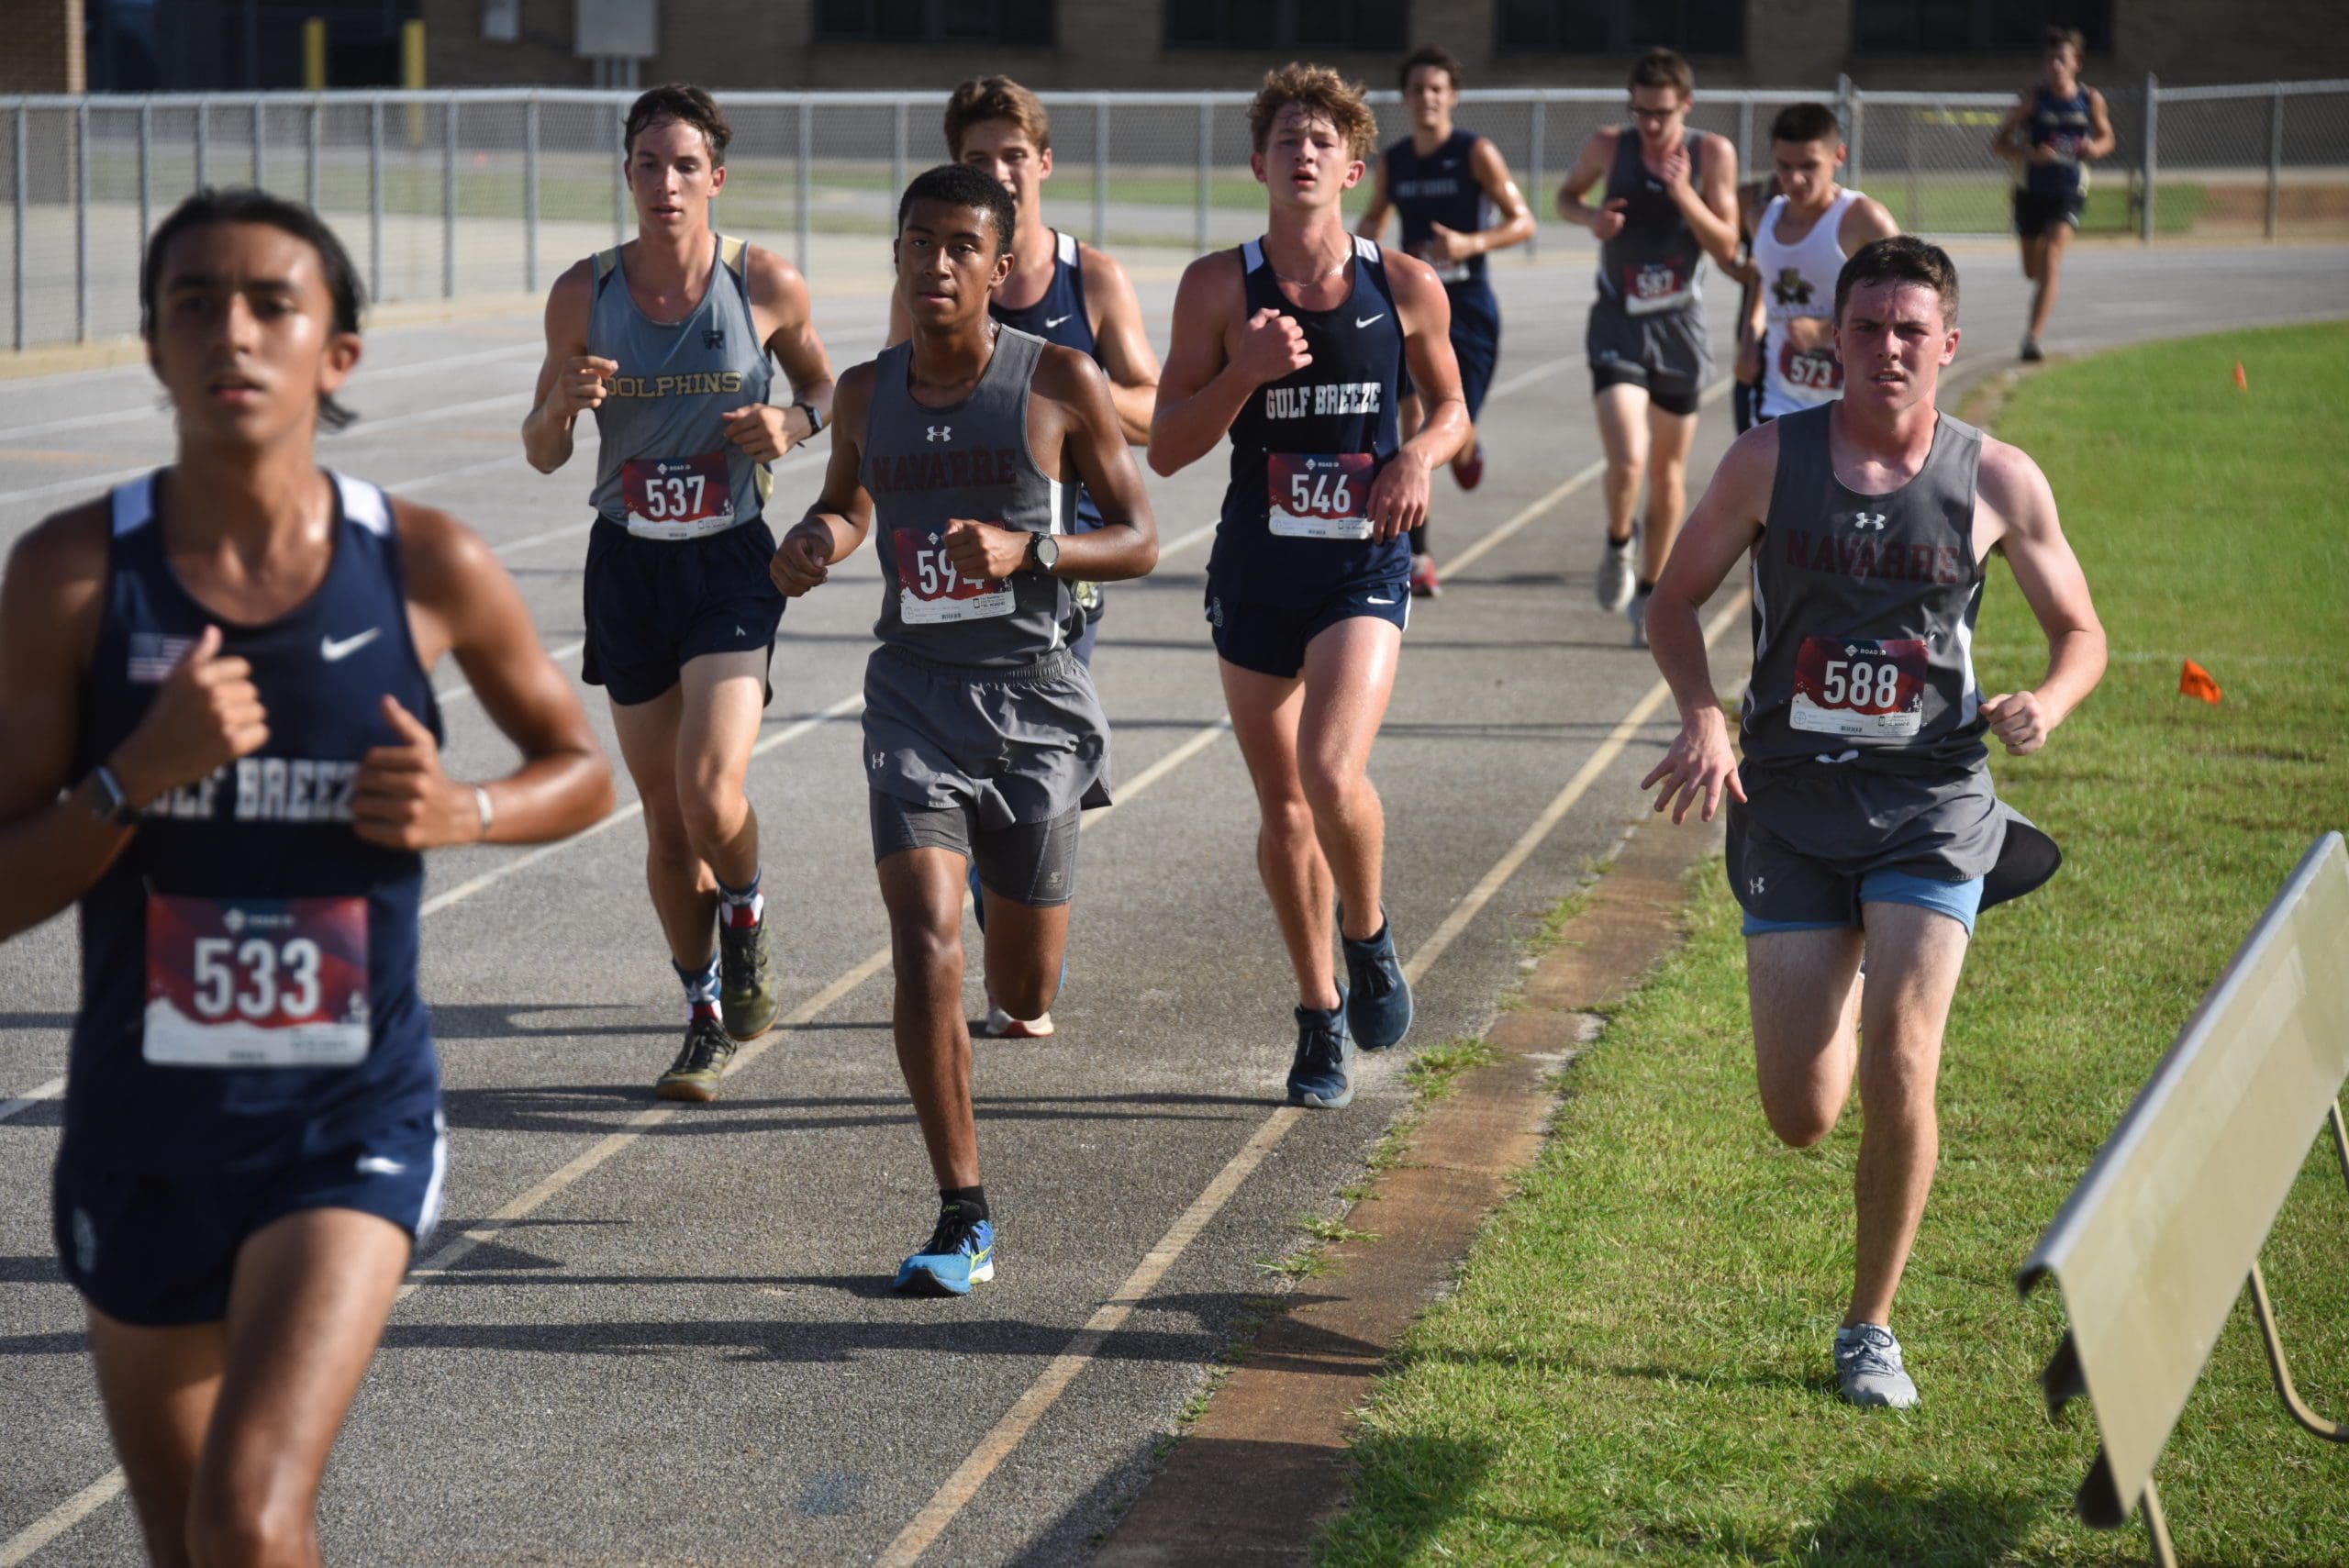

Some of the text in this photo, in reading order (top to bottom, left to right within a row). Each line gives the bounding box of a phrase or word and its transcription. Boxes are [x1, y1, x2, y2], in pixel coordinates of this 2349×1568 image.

[605, 371, 741, 397] DOLPHINS
[1790, 355, 1832, 386] 573
[1266, 382, 1381, 419] GULF BREEZE
[872, 449, 1017, 493] NAVARRE
[645, 474, 706, 517] 537
[1292, 473, 1351, 513] 546
[1786, 528, 1959, 584] NAVARRE
[1822, 660, 1898, 708] 588
[235, 758, 359, 819] BREEZ
[194, 937, 320, 1019] 533
